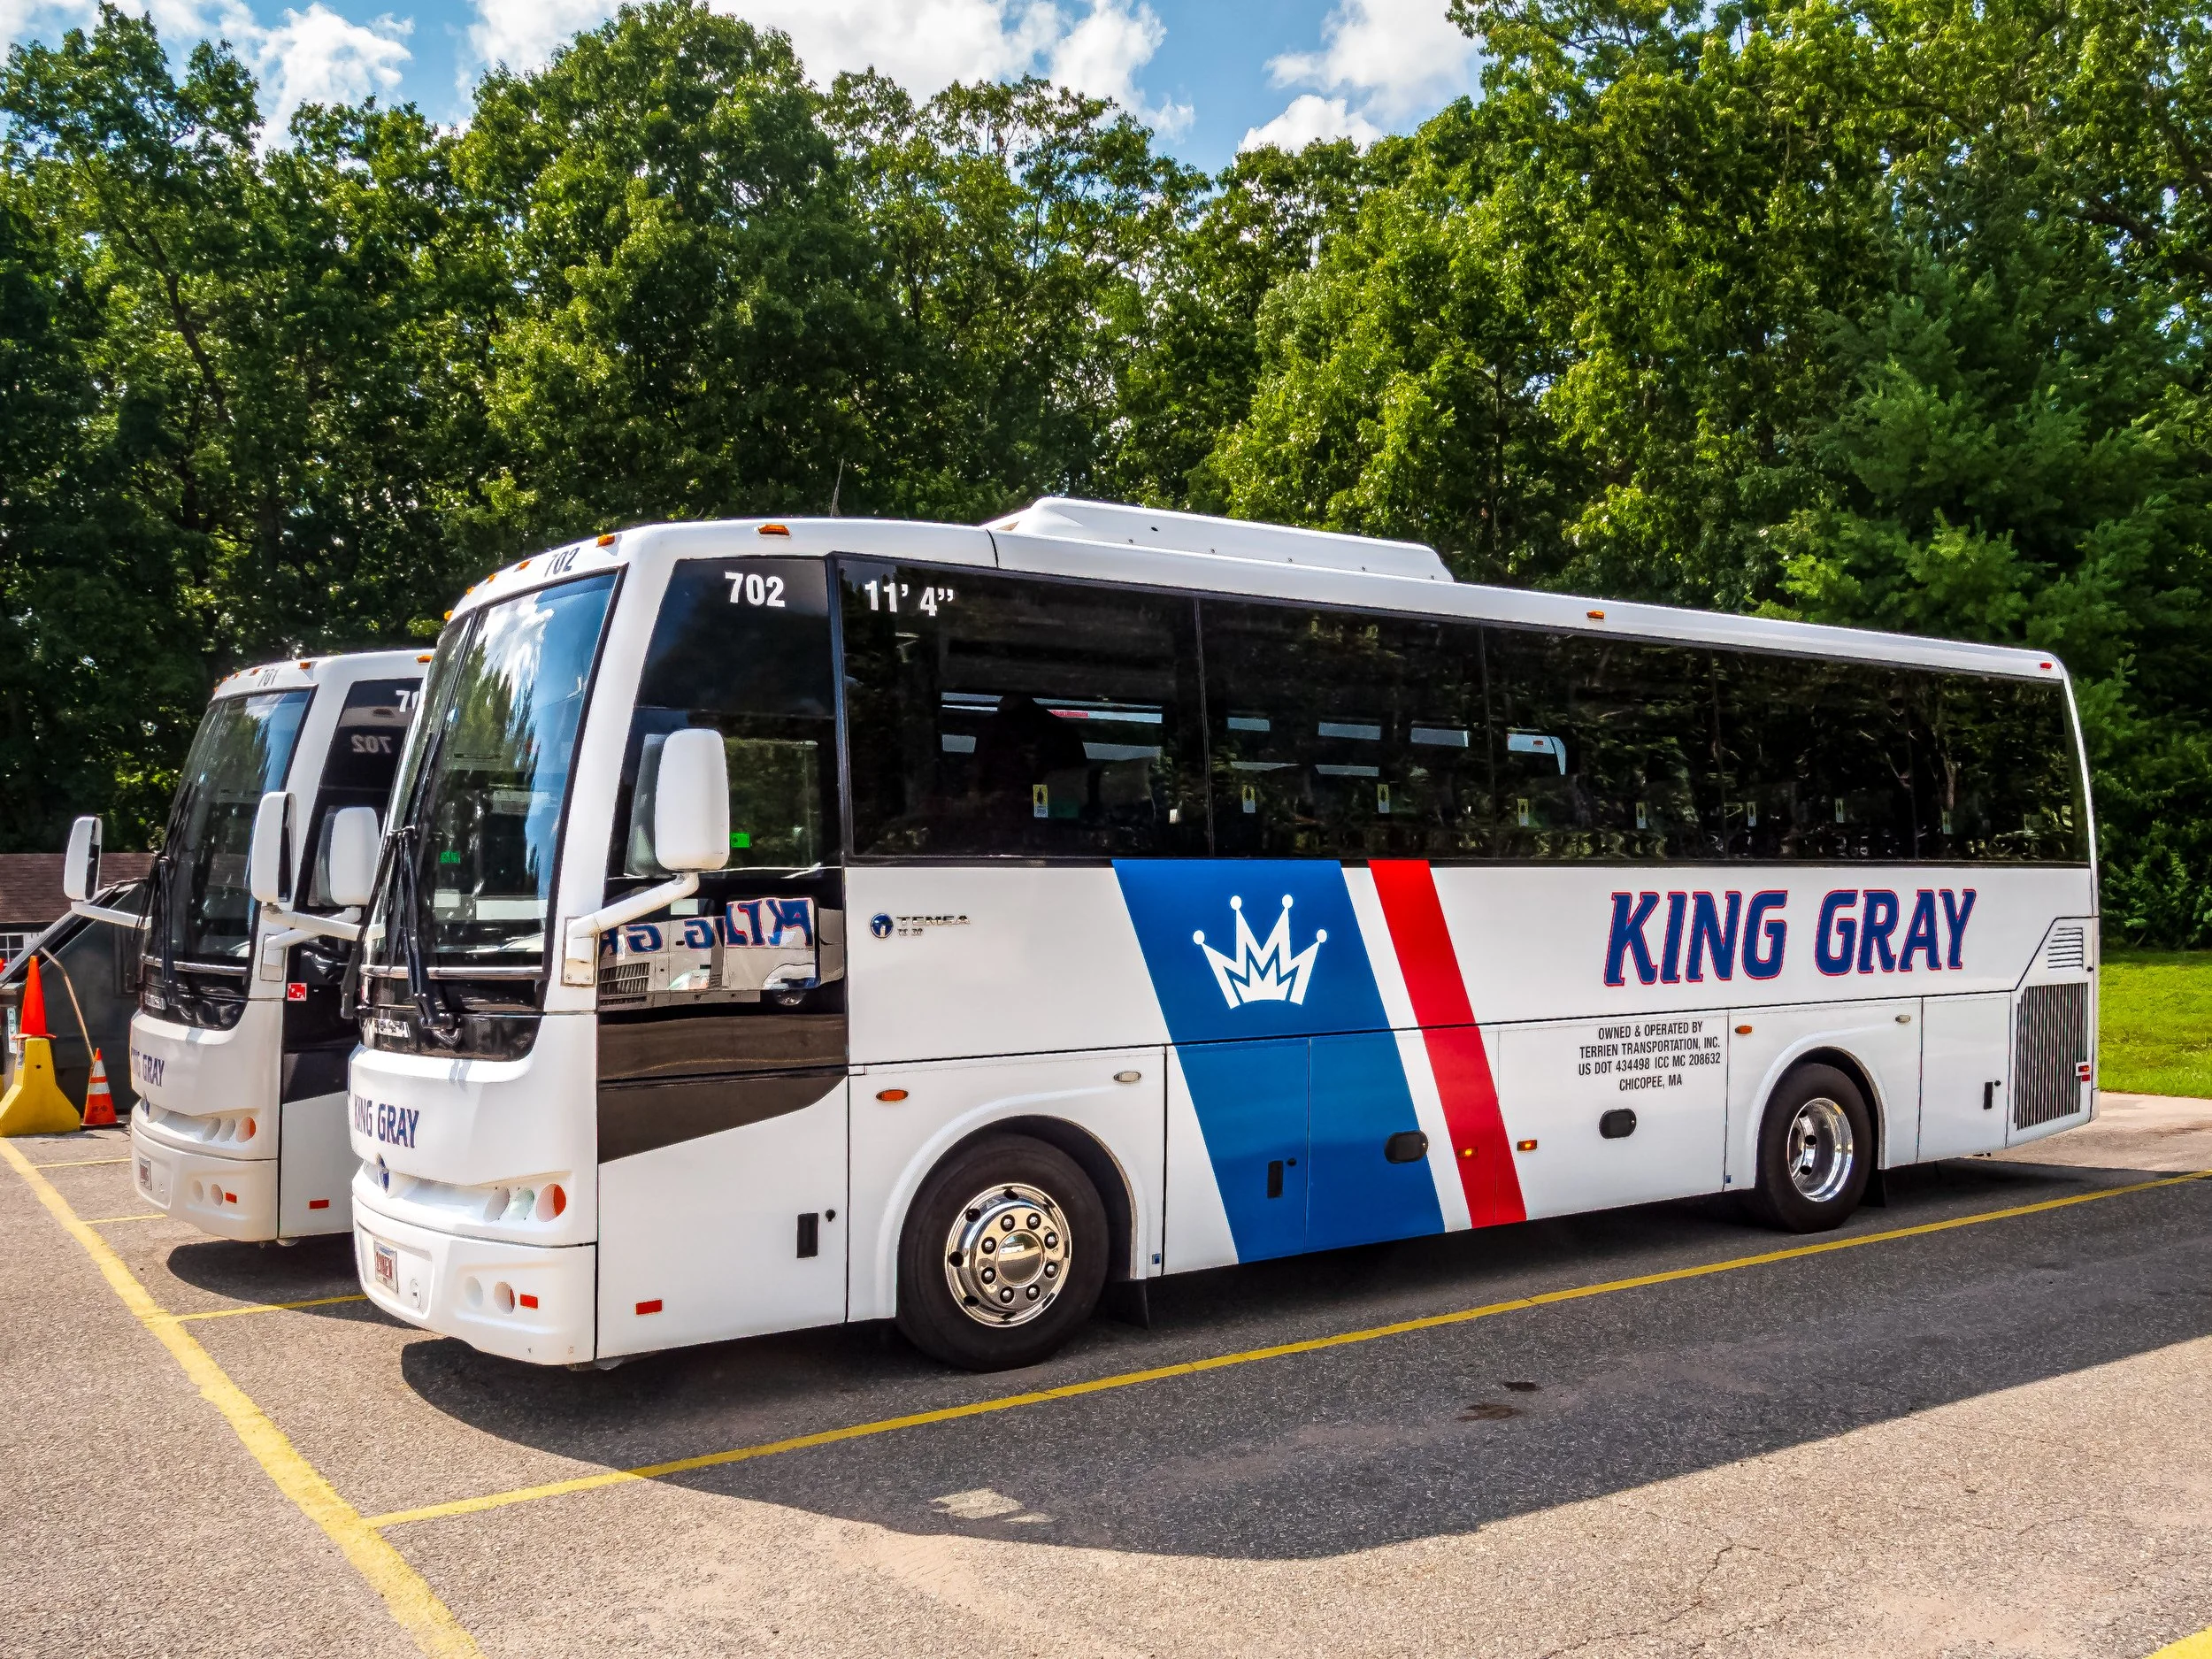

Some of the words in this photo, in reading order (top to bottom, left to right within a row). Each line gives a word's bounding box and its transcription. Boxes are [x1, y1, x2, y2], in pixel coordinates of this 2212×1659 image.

[544, 547, 580, 578] 702
[725, 571, 786, 608] 702
[1603, 889, 1788, 987] KING
[1815, 888, 1977, 977] GRAY
[1598, 1025, 1632, 1040] OWNED
[1634, 1025, 1641, 1037] &
[1644, 1022, 1689, 1037] OPERATED
[1692, 1021, 1703, 1033] BY
[1579, 1044, 1618, 1058] TERRIEN
[1621, 1038, 1701, 1055] TRANSPORTATION,
[1704, 1036, 1720, 1048] INC.
[142, 1054, 165, 1087] GRAY
[1578, 1064, 1591, 1075] US
[1594, 1061, 1612, 1074] DOT
[1616, 1058, 1650, 1072] 434498
[1655, 1056, 1670, 1069] ICC
[1672, 1056, 1686, 1067] MC
[1689, 1052, 1721, 1066] 208632
[1619, 1075, 1665, 1091] CHICOPEE,
[1668, 1074, 1682, 1087] MA
[377, 1103, 419, 1148] GRAY
